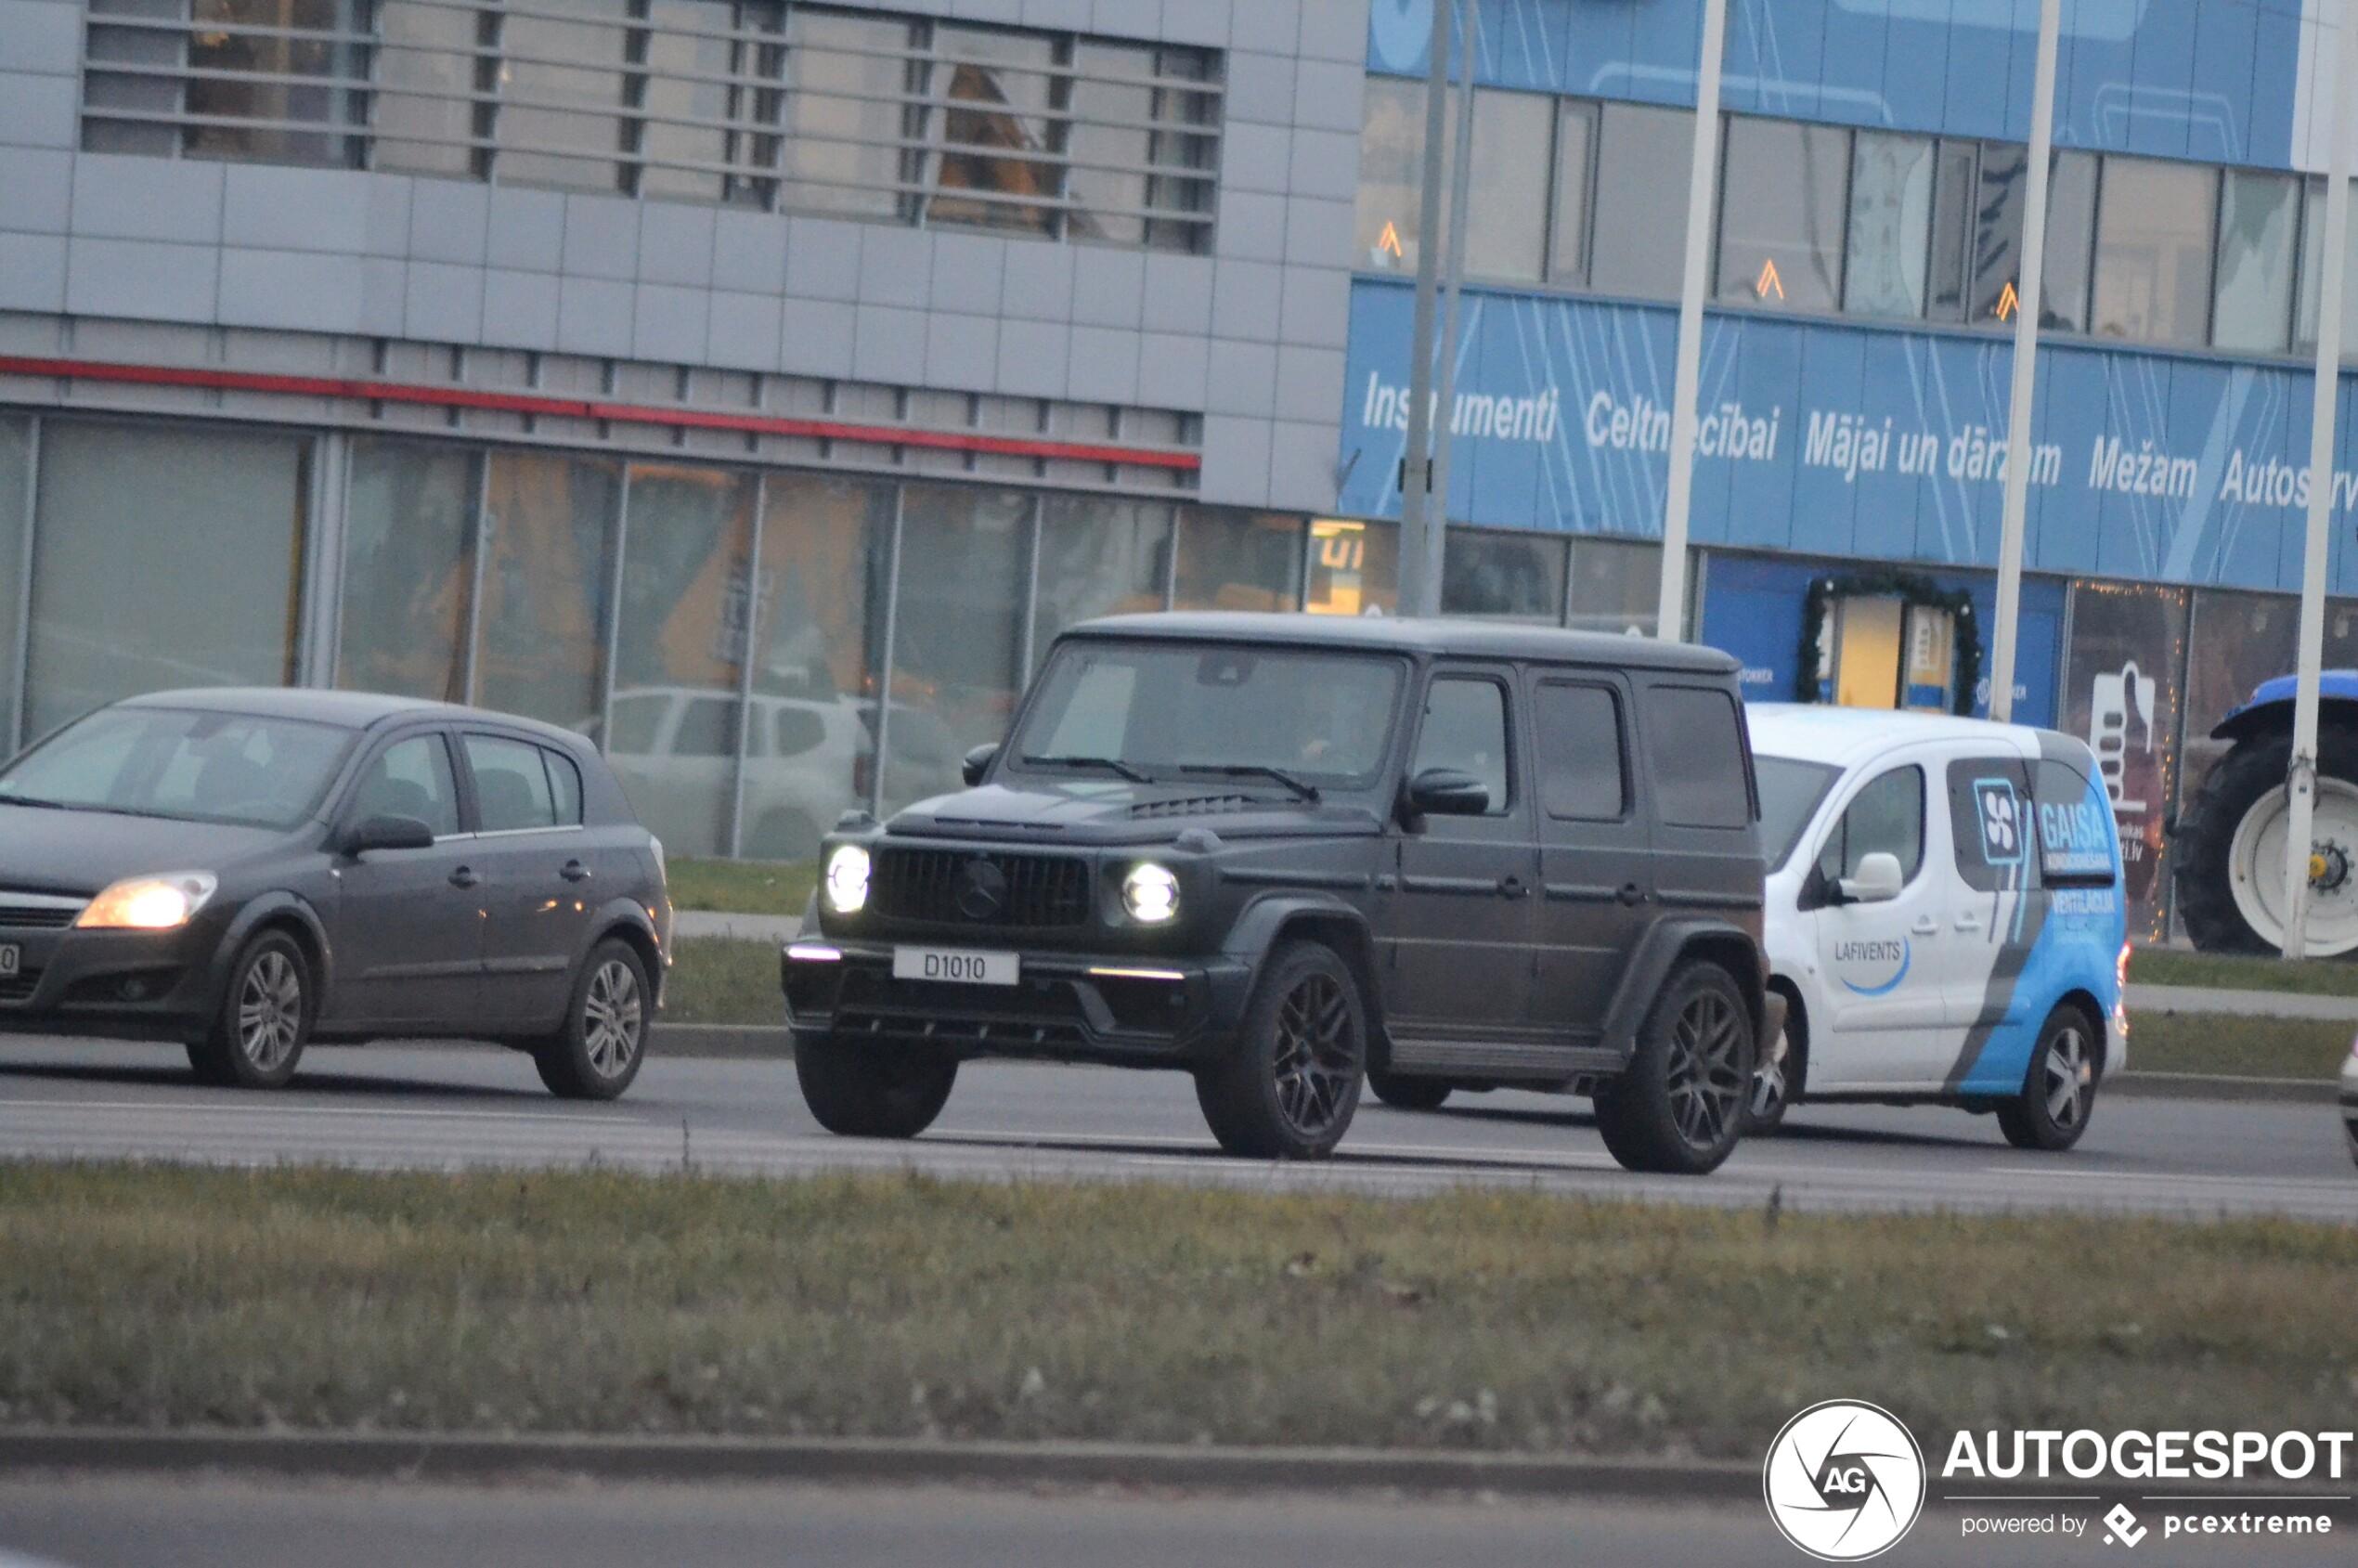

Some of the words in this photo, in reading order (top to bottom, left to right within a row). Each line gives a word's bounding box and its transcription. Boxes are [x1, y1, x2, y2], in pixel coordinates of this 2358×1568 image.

[1805, 410, 1892, 483] Mājai
[1898, 433, 1938, 476] un
[1948, 423, 2062, 486] dārzm
[2089, 434, 2197, 499] Mežam
[2042, 802, 2107, 850] GAISA
[925, 954, 985, 978] D1010
[1835, 941, 1900, 961] LAFIVENTS
